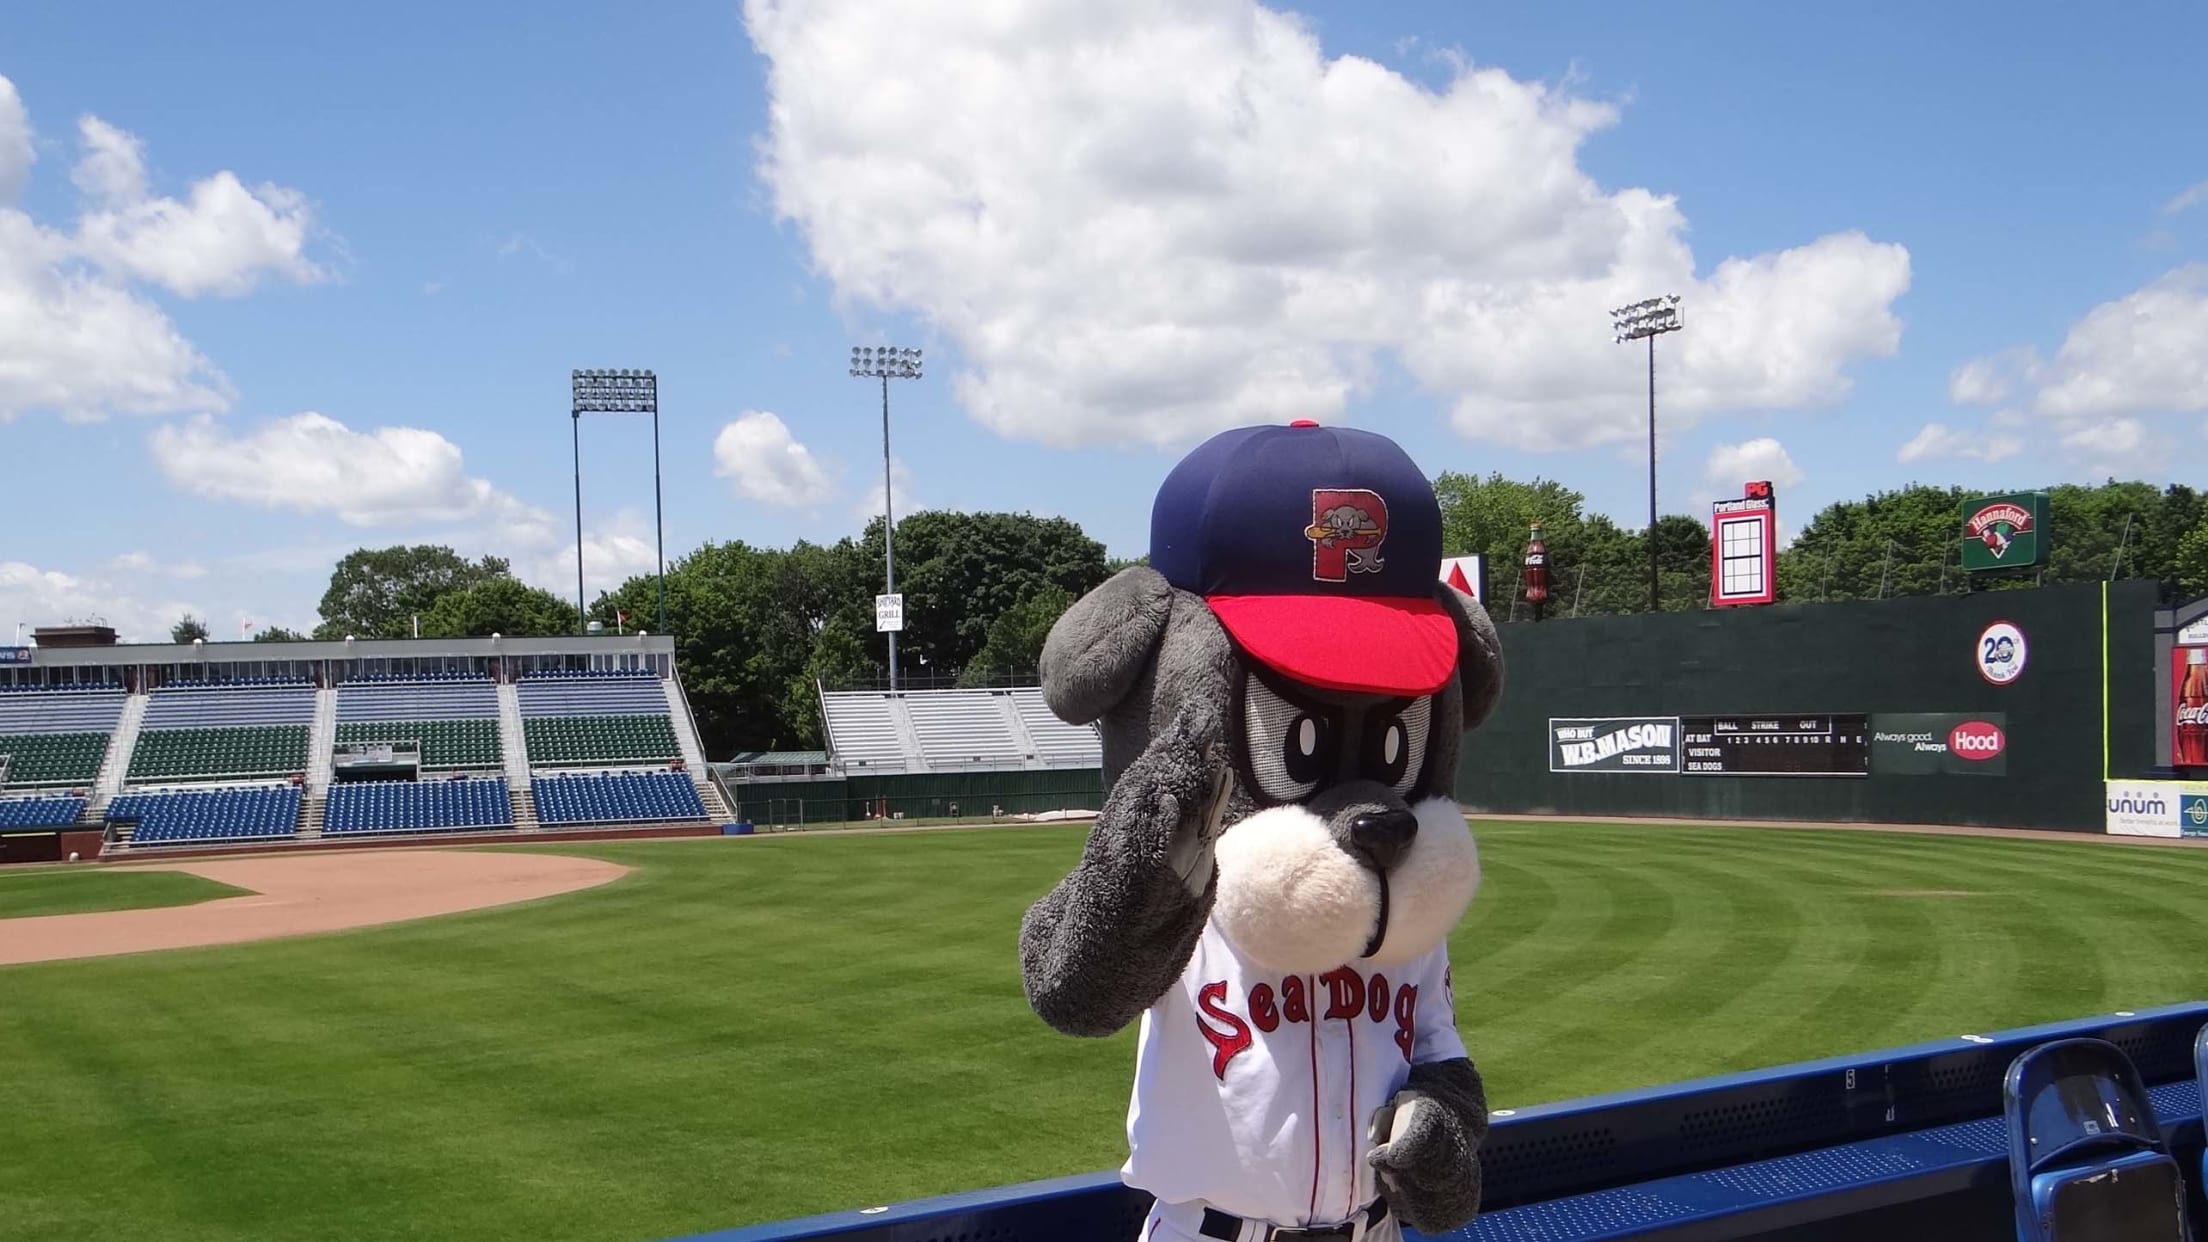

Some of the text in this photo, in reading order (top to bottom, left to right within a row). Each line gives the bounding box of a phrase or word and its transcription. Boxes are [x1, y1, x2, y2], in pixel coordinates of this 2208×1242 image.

[1745, 481, 1769, 498] PG
[1714, 500, 1745, 513] Portland
[1972, 508, 2027, 530] Hannaford
[878, 610, 900, 619] GRILL
[1718, 720, 1816, 730] BALL STRIKE OUT
[1557, 728, 1594, 740] WHO BUT
[1685, 734, 1712, 743] AT BAT
[1874, 732, 1905, 743] Always
[1955, 731, 1998, 750] Hood
[1914, 742, 1947, 752] Always
[1688, 748, 1721, 757] VISITOR
[1623, 755, 1651, 764] SINCE
[1688, 762, 1722, 771] SEA DOGS
